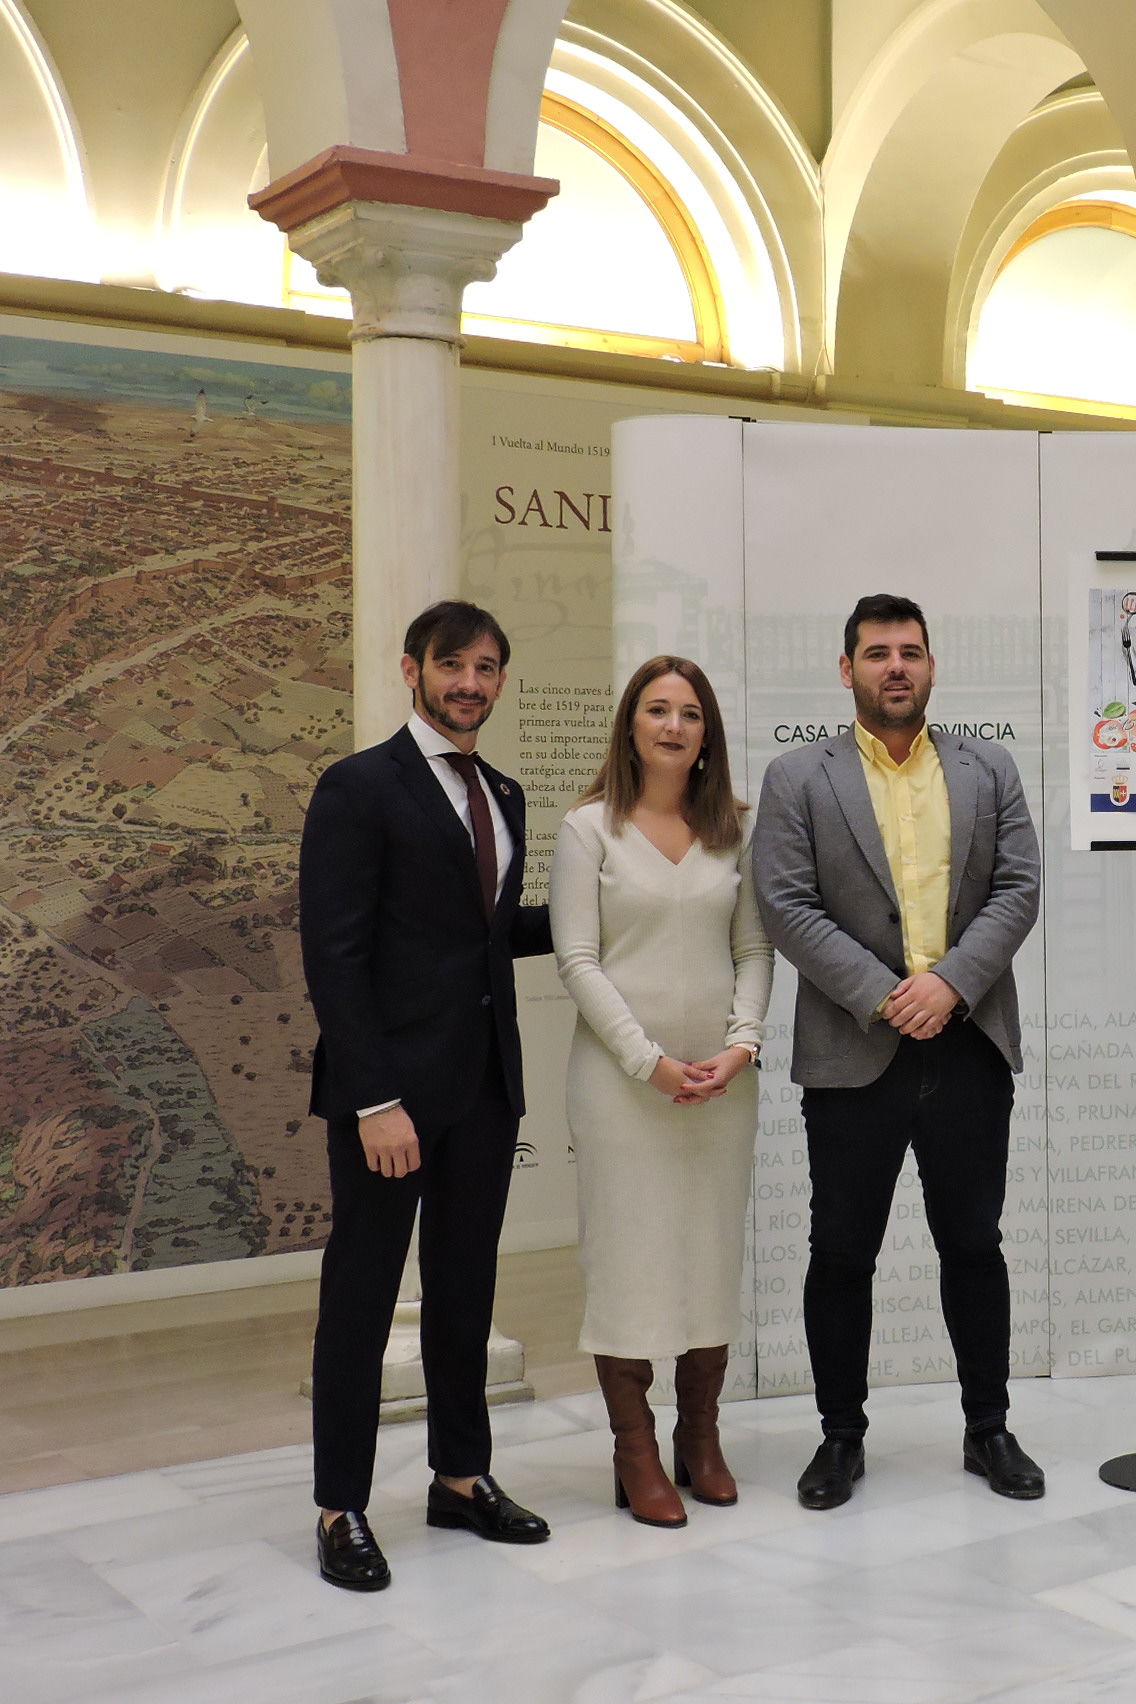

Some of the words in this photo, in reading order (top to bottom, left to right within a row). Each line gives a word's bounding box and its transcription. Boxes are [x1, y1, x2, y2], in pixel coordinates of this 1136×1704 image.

[499, 436, 532, 450] Vuelta
[534, 440, 544, 451] al
[547, 441, 584, 455] Mundo
[588, 445, 611, 457] 1519
[519, 679, 539, 694] Las
[542, 682, 571, 694] cinco
[574, 687, 602, 696] naves
[519, 698, 536, 710] bre
[540, 698, 552, 710] de
[556, 700, 580, 711] 1519
[583, 704, 605, 714] para
[519, 715, 560, 729] primera
[564, 716, 596, 728] vuelta
[598, 716, 607, 728] al
[519, 731, 532, 743] de
[535, 735, 547, 743] su
[774, 724, 829, 742] CASA
[520, 751, 532, 760] en
[536, 751, 547, 760] su
[550, 748, 580, 760] doble
[520, 764, 565, 778] tratégica
[559, 780, 575, 792] del
[527, 796, 558, 808] evilla.
[536, 832, 559, 840] casc
[526, 847, 555, 857] esem
[522, 895, 538, 906] del
[1021, 1009, 1097, 1031] ALUCÍA,
[1050, 1040, 1134, 1061] CAÑADA
[1013, 1073, 1080, 1091] NUEVA
[1088, 1073, 1122, 1090] DEL
[1012, 1104, 1070, 1124] MITAS,
[1031, 1166, 1042, 1182] Y
[768, 1210, 808, 1231] RÍO,
[1018, 1197, 1107, 1214] MAIRENA
[745, 1244, 804, 1265] ILLOS,
[892, 1235, 914, 1251] LA
[1055, 1225, 1131, 1245] SEVILLA,
[872, 1296, 941, 1314] RISCAL,
[872, 1326, 934, 1345] ILLEJA
[1012, 1318, 1062, 1340] MPO,
[1071, 1320, 1091, 1335] EL
[1010, 1345, 1057, 1368] OLÁS
[1068, 1349, 1104, 1367] DEL
